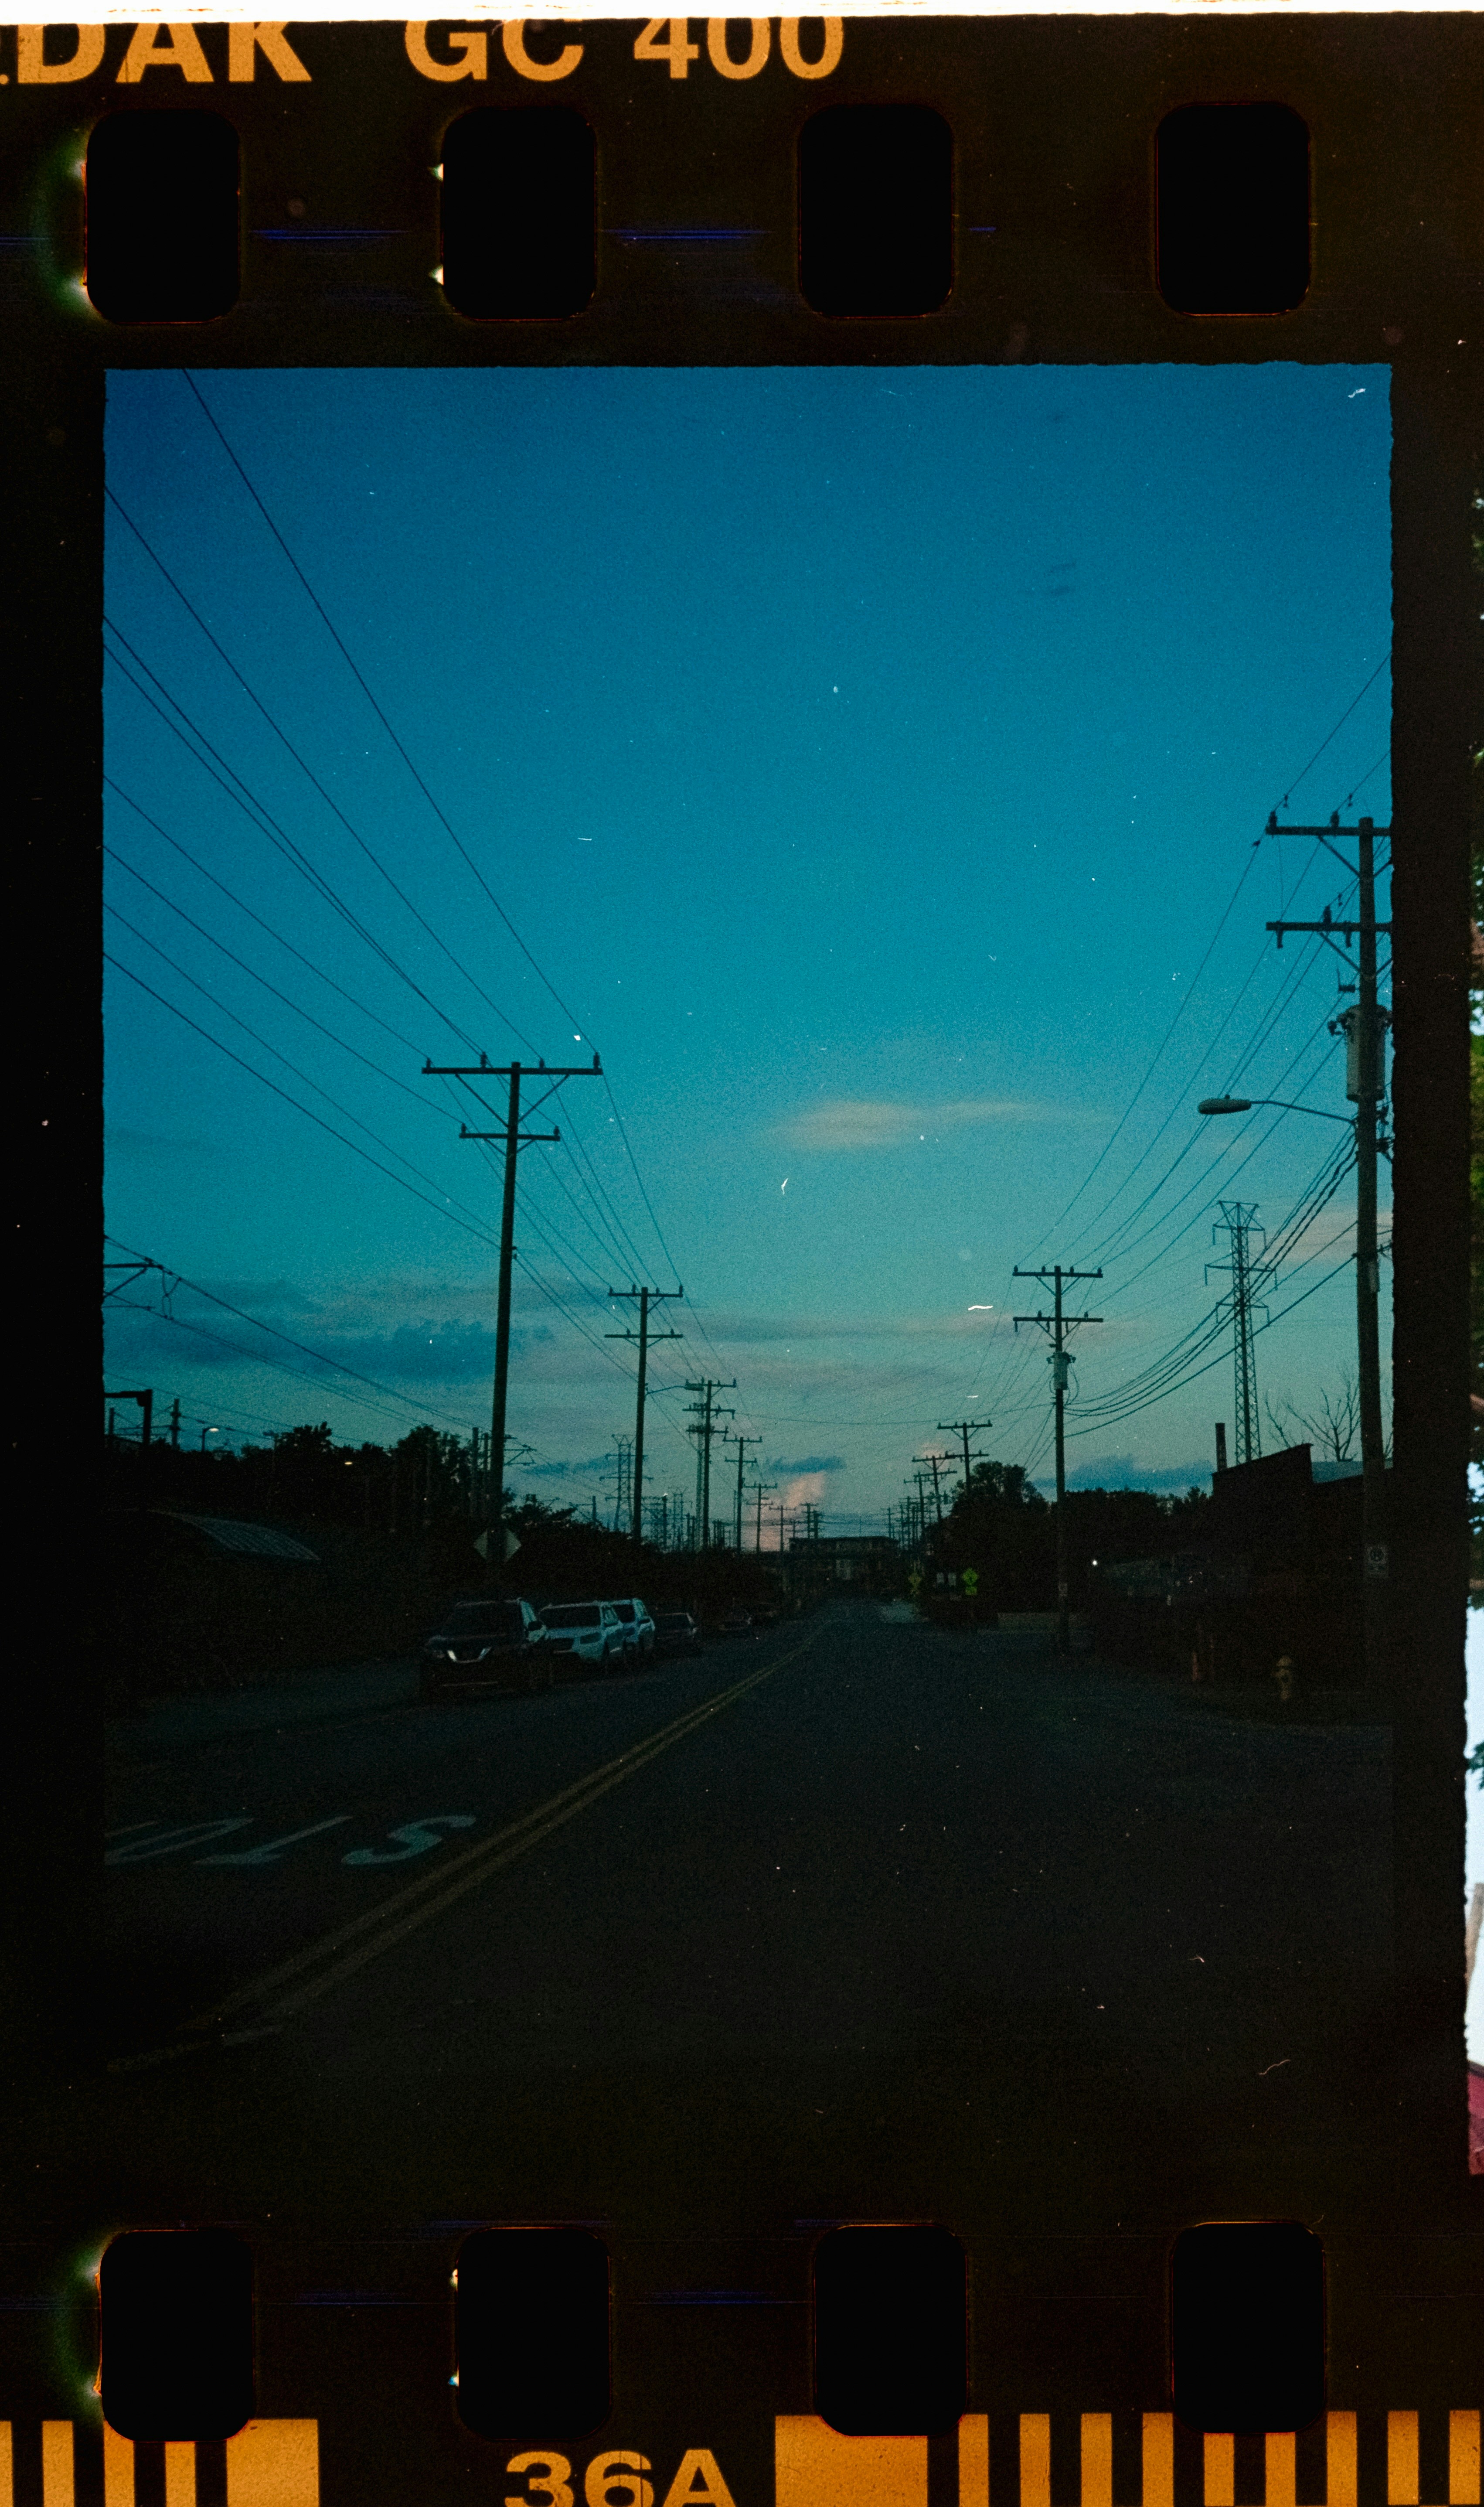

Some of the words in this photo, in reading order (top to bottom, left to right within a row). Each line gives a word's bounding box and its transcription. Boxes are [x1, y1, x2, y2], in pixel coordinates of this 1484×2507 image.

[405, 19, 585, 82] GC
[633, 17, 844, 80] 400
[103, 1815, 477, 1866] STO
[504, 2449, 738, 2507] 36A
